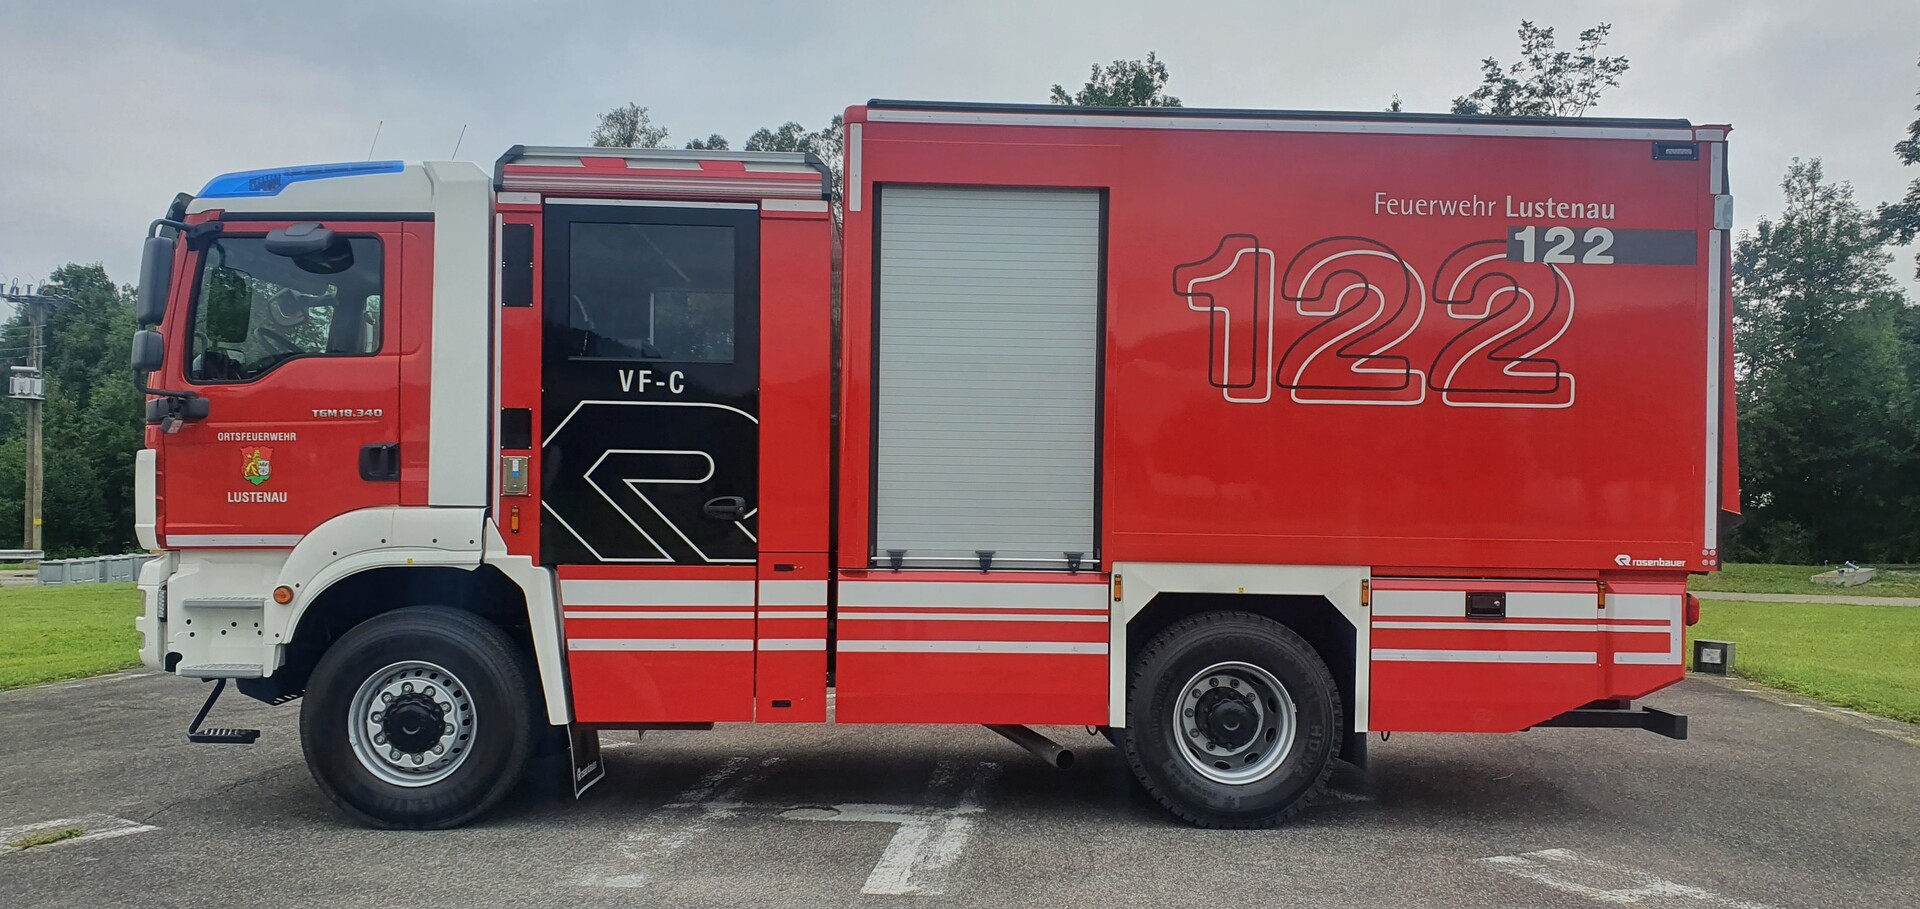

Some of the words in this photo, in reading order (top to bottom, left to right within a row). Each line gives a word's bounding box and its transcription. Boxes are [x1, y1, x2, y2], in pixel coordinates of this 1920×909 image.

[1373, 192, 1497, 217] Feuerwehr
[1505, 195, 1616, 220] Lustenau
[1514, 225, 1615, 264] 122
[1173, 233, 1576, 409] 122
[618, 369, 685, 394] VF-C
[217, 431, 297, 442] ORTSFEUERWEHR
[227, 491, 289, 503] LUSTENAU
[1632, 557, 1687, 567] rosenbauer
